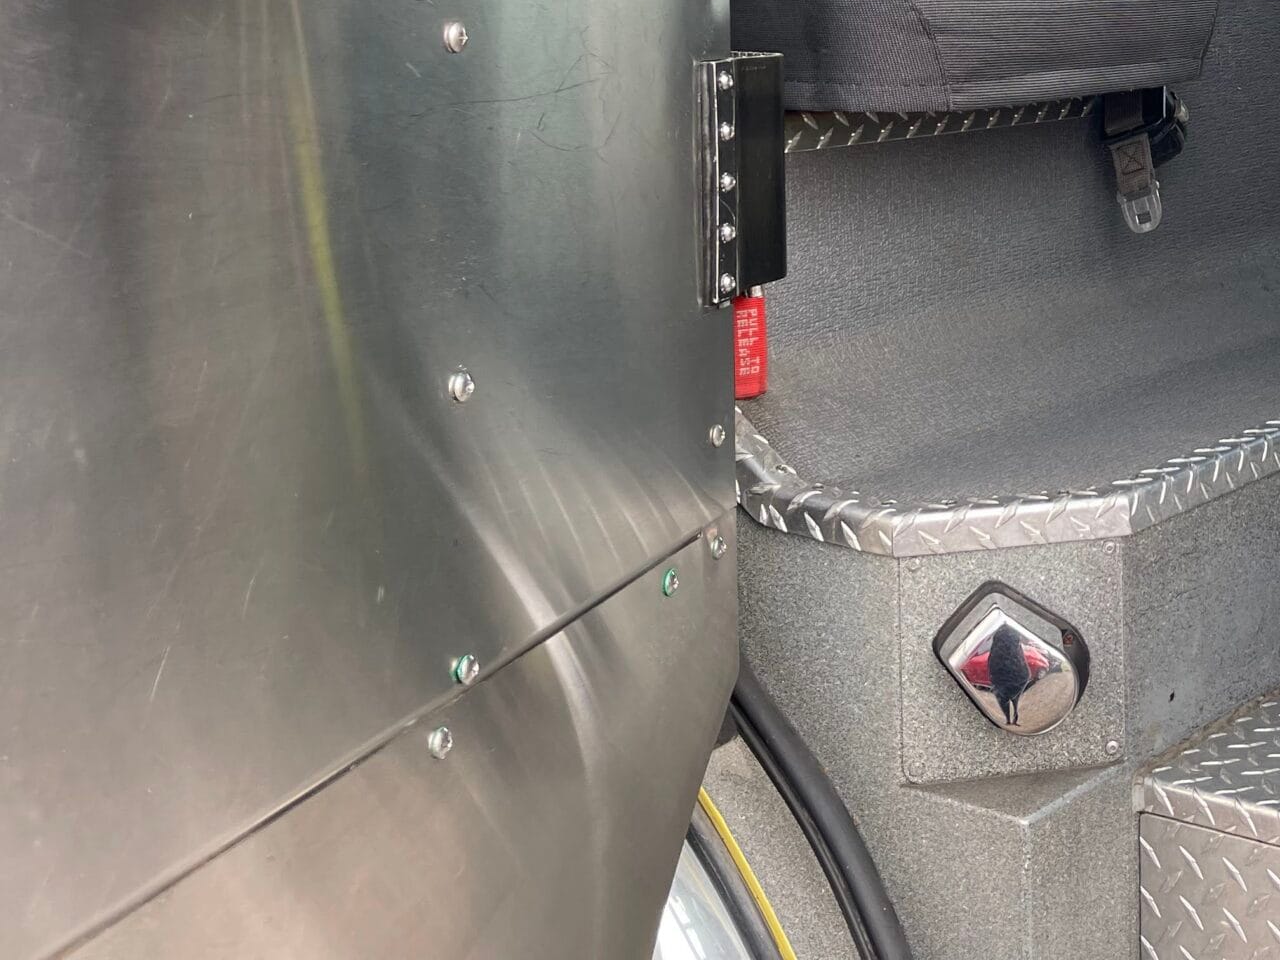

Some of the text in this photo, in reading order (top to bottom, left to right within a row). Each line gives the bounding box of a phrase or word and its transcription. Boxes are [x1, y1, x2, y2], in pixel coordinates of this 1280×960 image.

[736, 310, 751, 376] RELEASE
[749, 308, 760, 374] PULL TO
